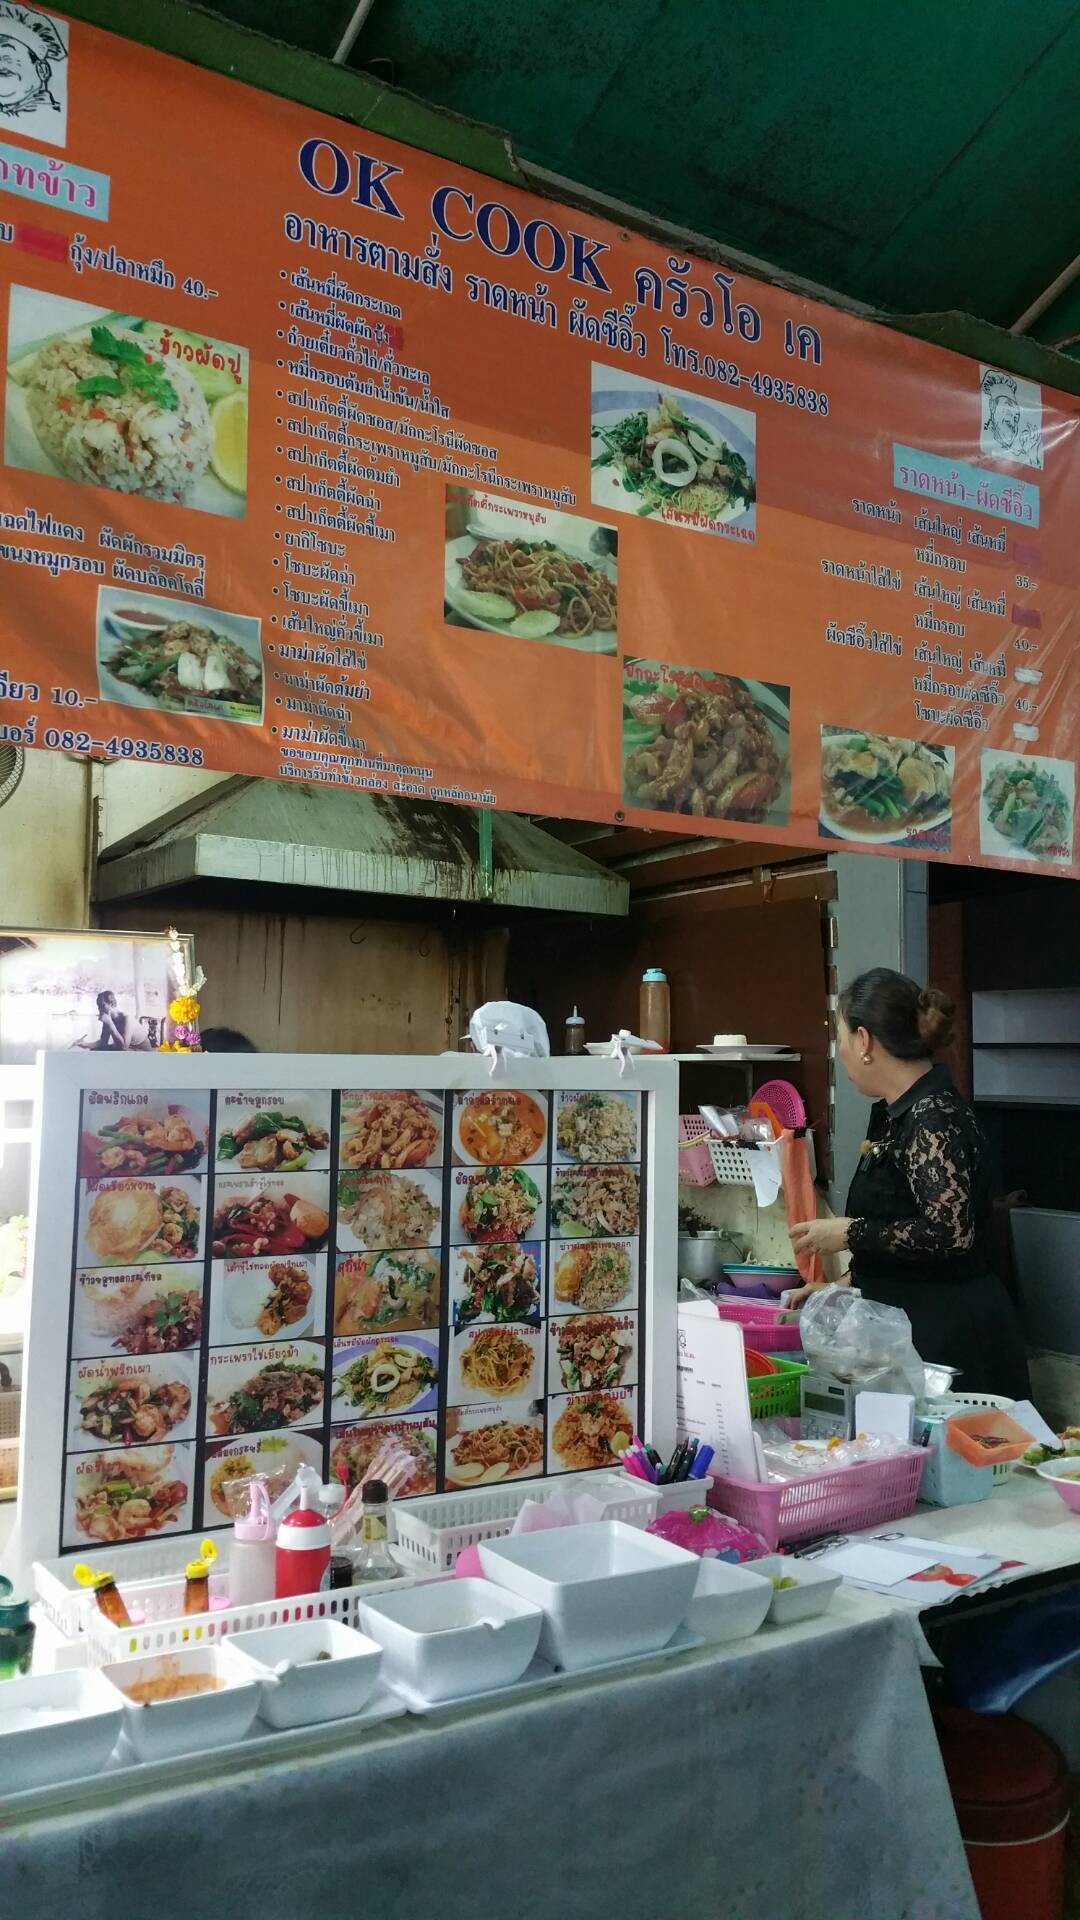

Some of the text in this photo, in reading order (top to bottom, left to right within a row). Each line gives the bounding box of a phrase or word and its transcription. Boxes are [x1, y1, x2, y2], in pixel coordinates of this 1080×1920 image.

[298, 138, 612, 294] OK COOK
[183, 278, 218, 298] 40.-
[284, 212, 452, 293] อาหารตามสั่ง
[465, 273, 557, 328] ราดหน้า
[568, 298, 646, 358] ผัดซีอิ๊ว
[290, 268, 402, 320] เส้นหมี่ผัดกระเฉด
[634, 256, 821, 366] ครัวโอ เค
[160, 328, 242, 384] ข้าวผัดปู
[851, 498, 1007, 552] ราดหน้า เส้นใหญ่ เส้นหมี่
[98, 527, 206, 570] ผัดผักรวมมิตร
[285, 530, 346, 557] ยากิโซบะ
[914, 539, 966, 573] หมี่กรอบ
[283, 552, 356, 585] โซบะผัดฉ่า
[283, 581, 370, 617] โซบะผัดขี้เมา
[821, 559, 902, 592] ราดหน้าใส่ไข่
[913, 576, 961, 610] เส้นใหญ่
[967, 591, 1006, 616] เส้นหมี่
[913, 604, 965, 637] หมี่กรอบ
[279, 641, 367, 670] มาม่าผัดใส่ไข่
[914, 640, 963, 673] เส้นใหญ่
[51, 687, 98, 708] 10.-
[45, 728, 204, 767] 082-4935838
[393, 780, 425, 795] สะอาด
